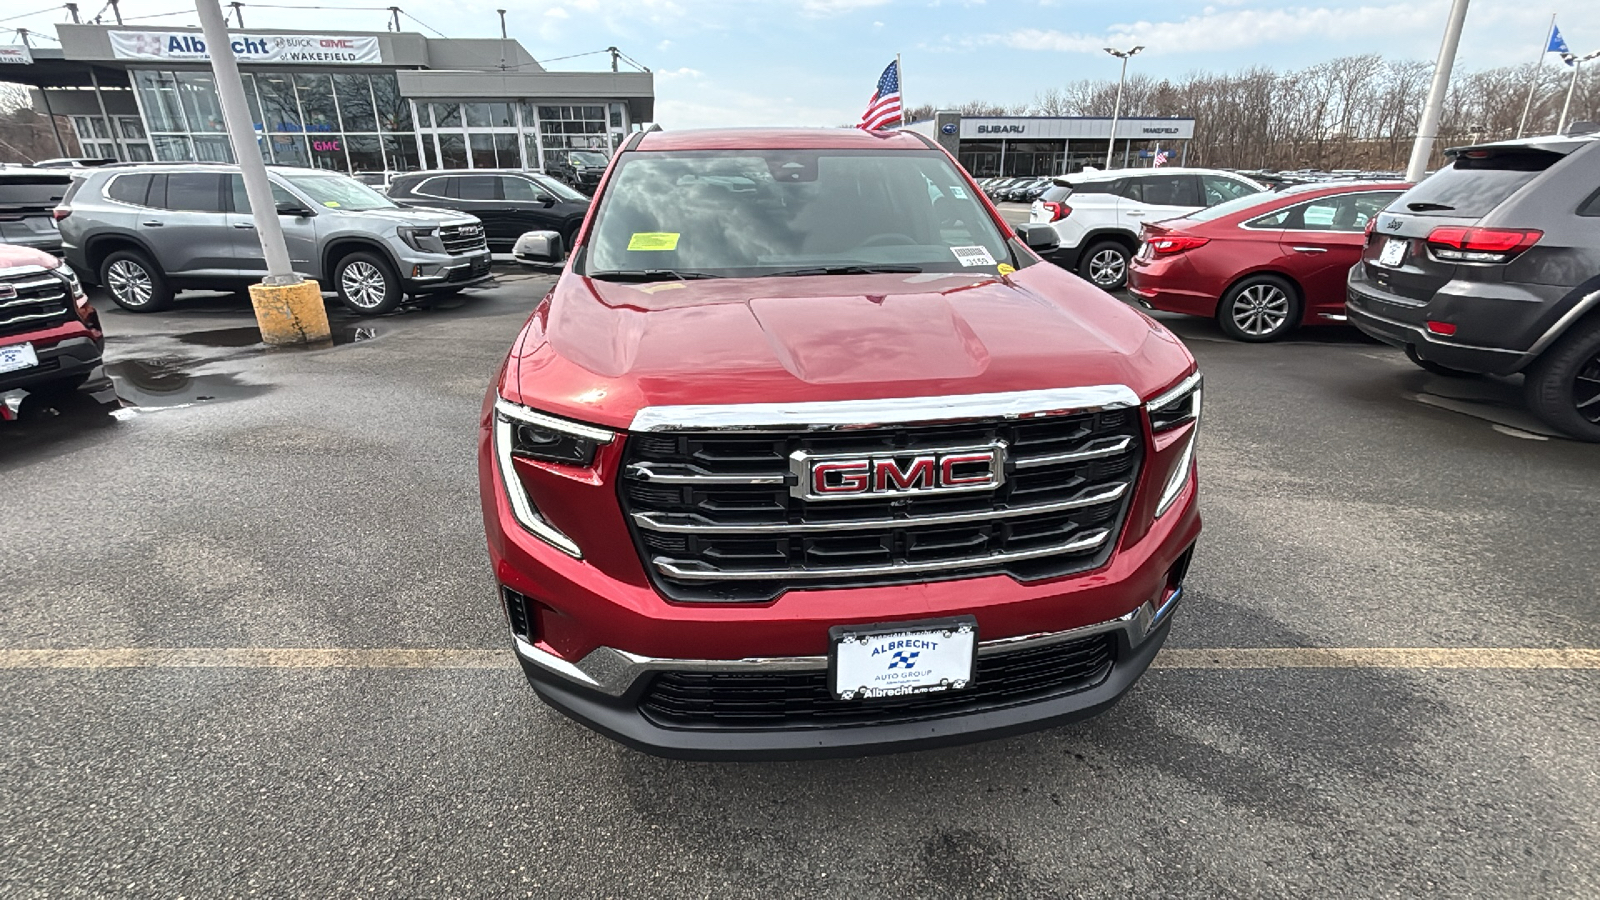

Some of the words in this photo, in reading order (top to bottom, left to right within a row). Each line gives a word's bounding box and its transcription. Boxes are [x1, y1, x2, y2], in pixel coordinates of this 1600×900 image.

[168, 35, 269, 54] Albcht
[286, 38, 313, 48] BUICK
[320, 39, 354, 48] GMC
[291, 52, 356, 61] WAKEFIELD
[977, 124, 1025, 134] SUBARU
[313, 141, 341, 151] GMC
[812, 451, 993, 495] GMC
[871, 639, 938, 657] ALBRECHT
[874, 672, 899, 681] AUTO
[901, 669, 932, 678] GROUP
[863, 684, 912, 698] Albrecht
